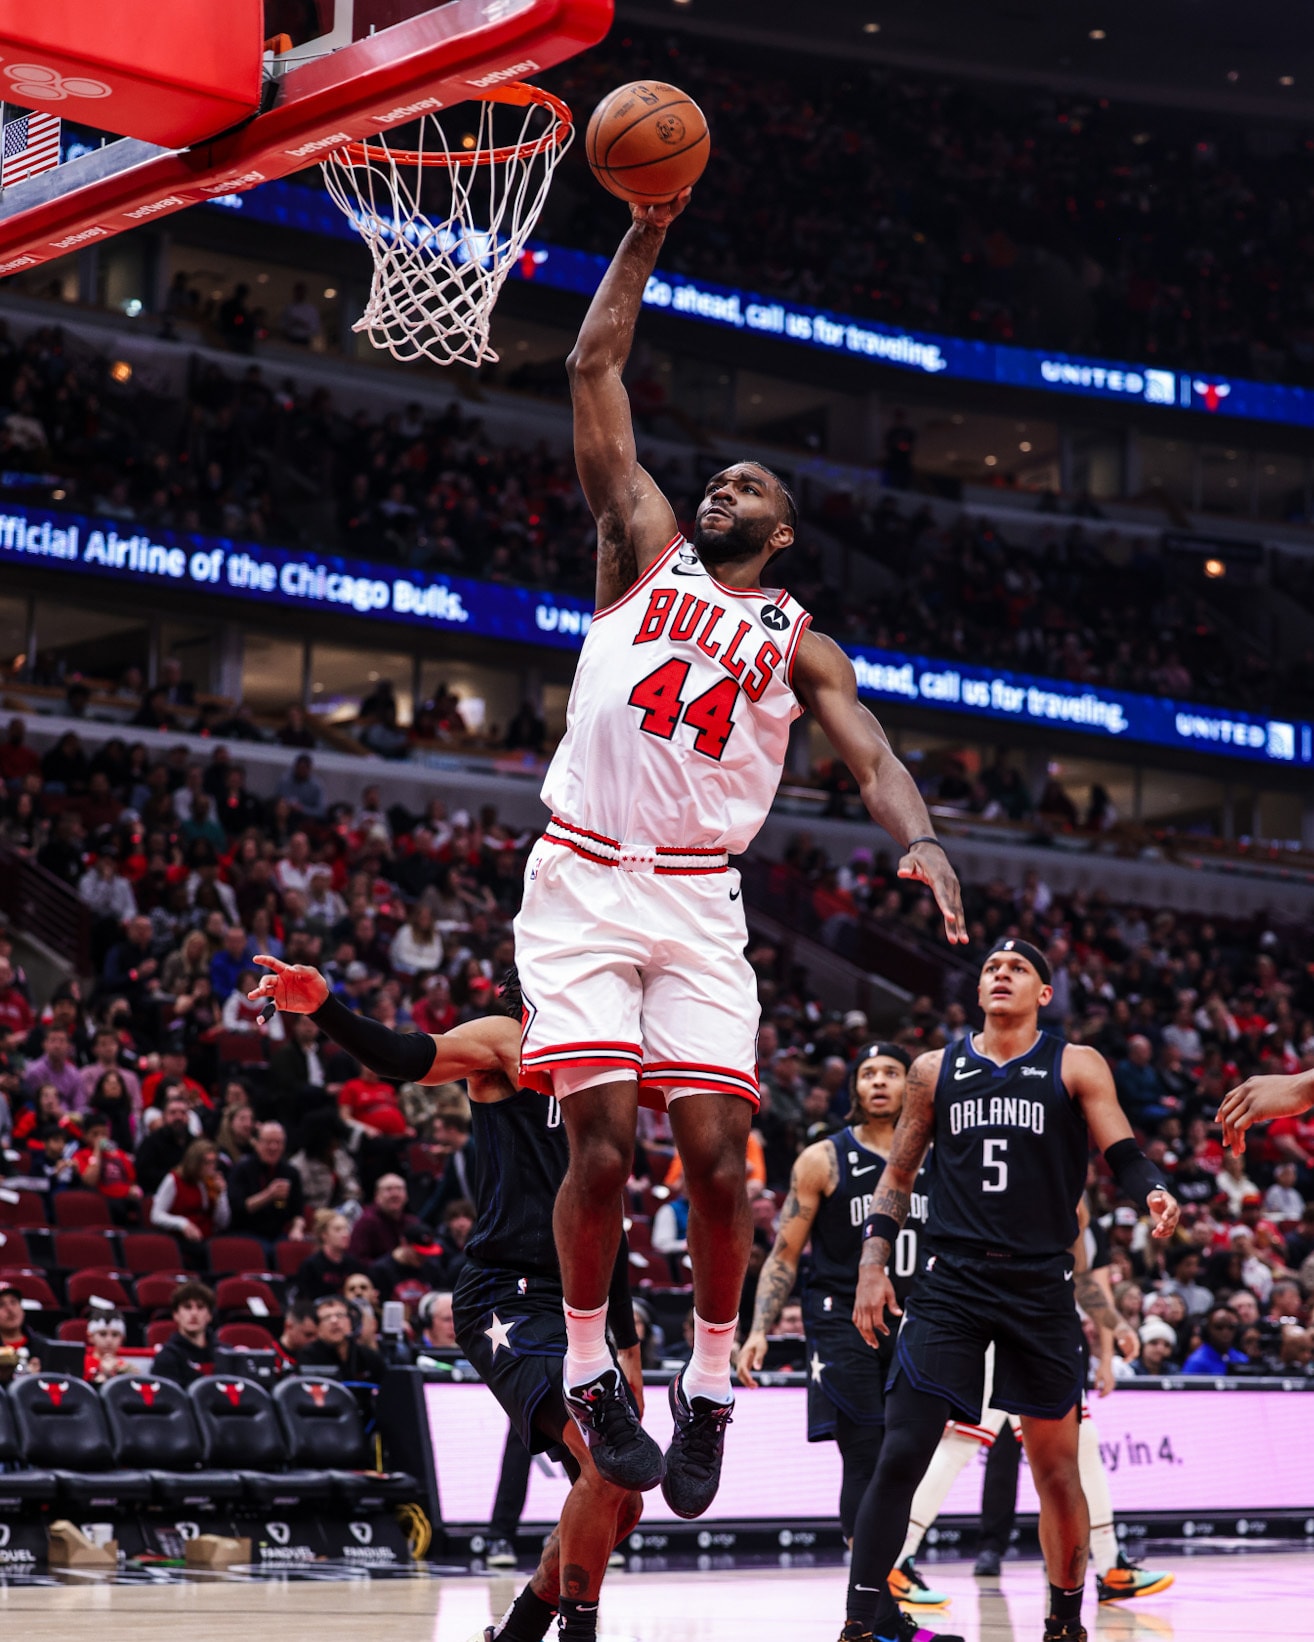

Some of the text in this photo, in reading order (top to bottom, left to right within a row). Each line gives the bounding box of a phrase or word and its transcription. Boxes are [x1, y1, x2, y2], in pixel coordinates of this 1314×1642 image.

[466, 59, 540, 88] betway
[372, 96, 443, 124] betway
[284, 131, 352, 157] betway
[123, 195, 184, 219] betway
[49, 225, 107, 249] betway
[1041, 361, 1143, 393] UNITED
[84, 531, 186, 578] Airline
[190, 549, 224, 583] of
[227, 554, 277, 592] the
[280, 563, 389, 612] Chicago
[392, 580, 468, 622] Bulls.
[536, 604, 593, 637] UNI
[632, 589, 782, 702] BULLS
[627, 657, 741, 761] 44
[1175, 712, 1265, 748] UNITED
[949, 1097, 1045, 1135] ORLANDO
[982, 1138, 1008, 1192] 5
